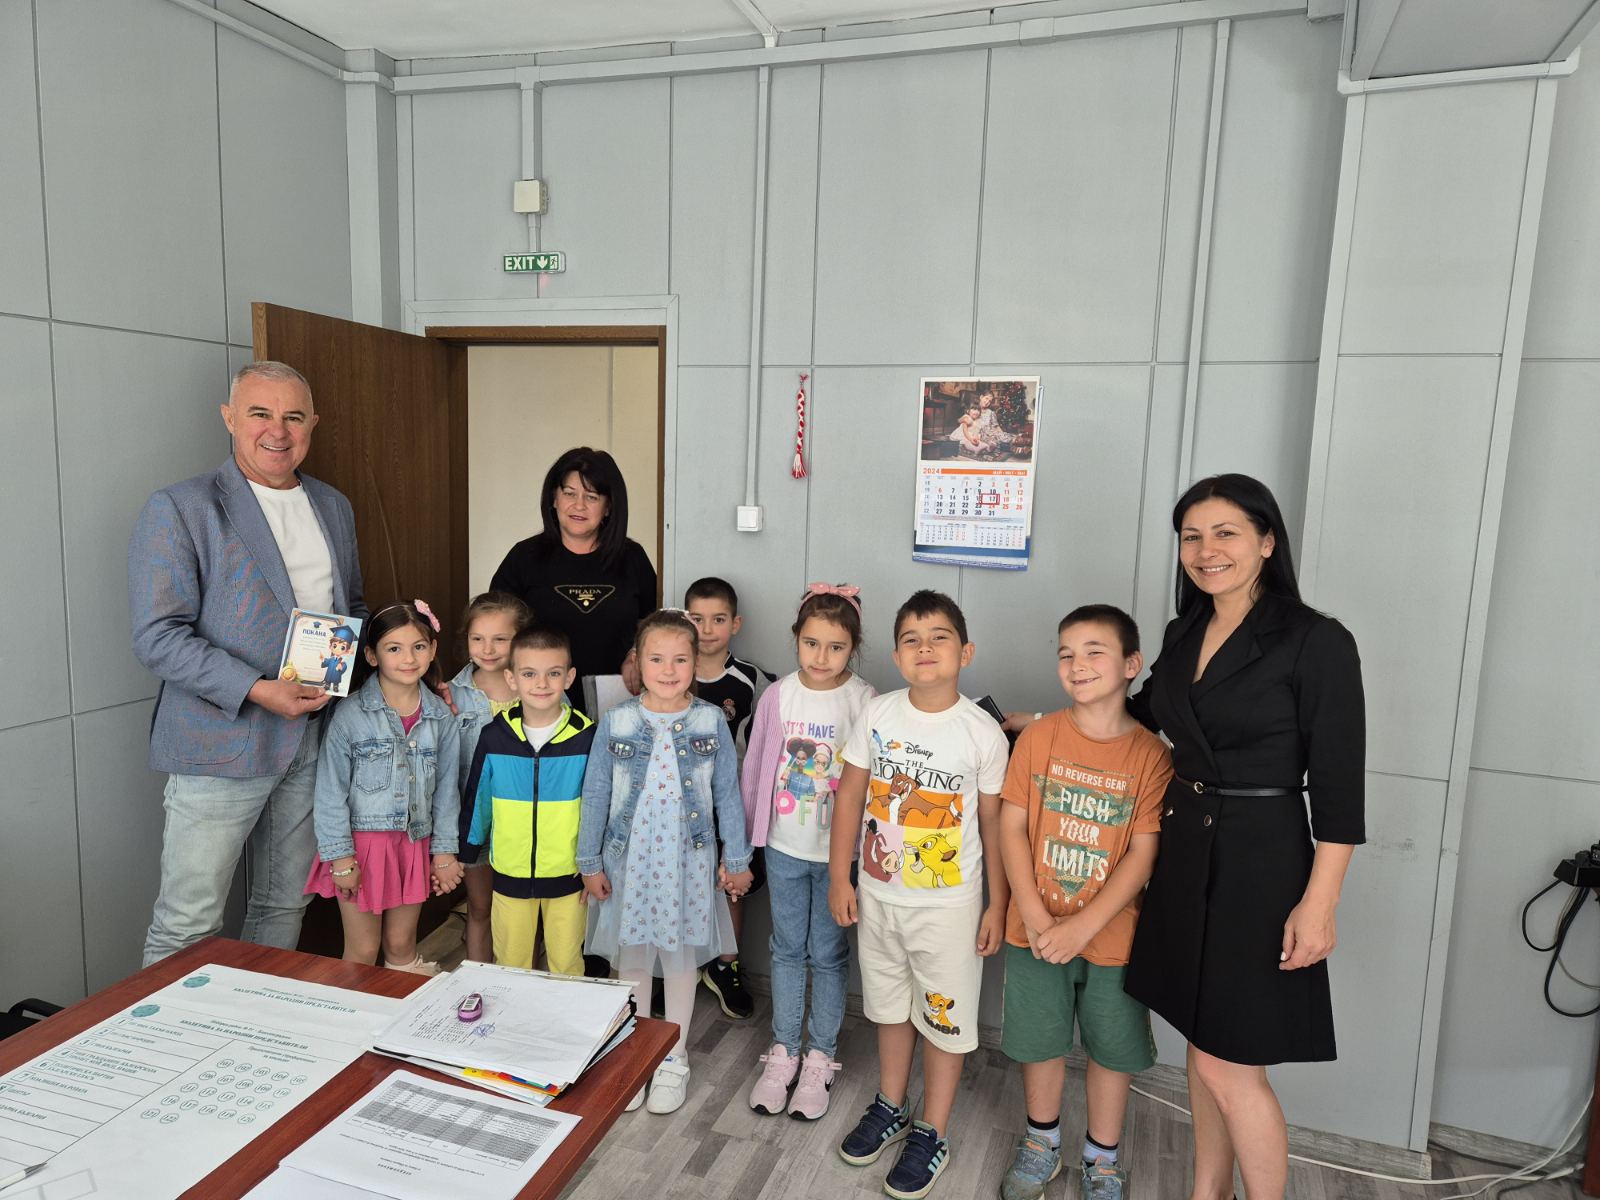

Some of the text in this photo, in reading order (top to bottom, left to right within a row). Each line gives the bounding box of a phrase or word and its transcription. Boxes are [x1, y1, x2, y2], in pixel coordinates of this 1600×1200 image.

[505, 257, 534, 270] EXIT
[302, 628, 326, 637] ПОКАНА
[808, 722, 835, 738] HAVE
[904, 741, 933, 760] Disney
[872, 758, 964, 791] LION KING
[906, 760, 924, 768] THE
[1051, 763, 1127, 791] NO REVERSE GEAR
[1059, 787, 1110, 822] PUSH
[1059, 817, 1100, 846] YOUR
[1042, 840, 1109, 882] LIMITS
